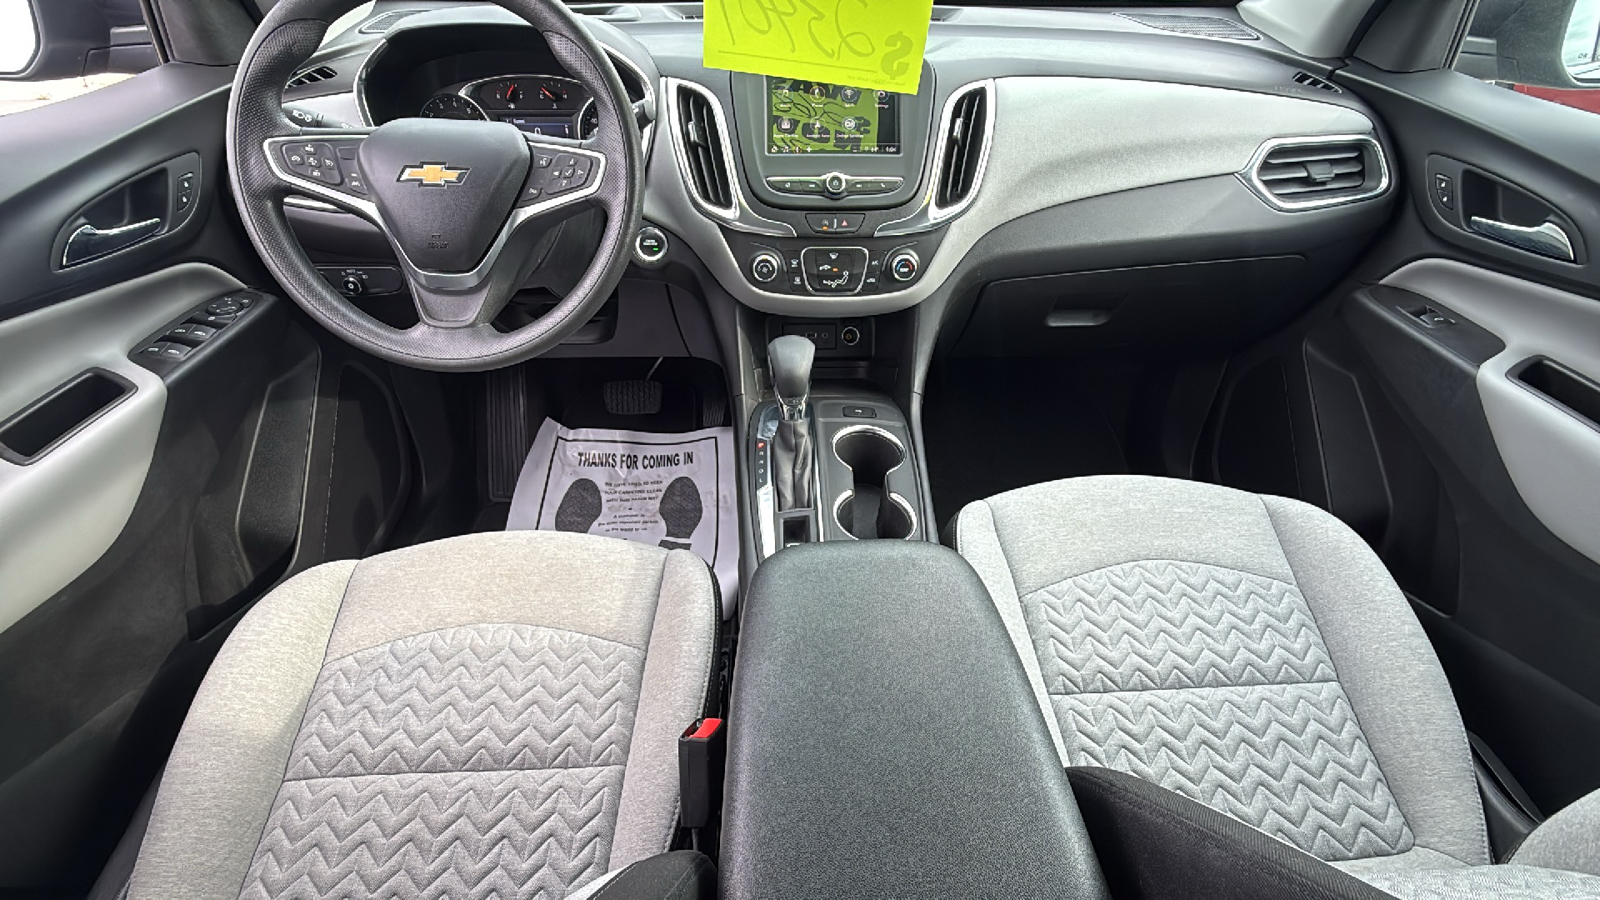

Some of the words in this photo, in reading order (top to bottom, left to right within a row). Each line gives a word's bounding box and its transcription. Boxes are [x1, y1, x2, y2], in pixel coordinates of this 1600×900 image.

[578, 452, 617, 468] THANKS
[620, 453, 638, 470] FOR
[642, 453, 680, 469] COMING
[683, 451, 694, 465] IN
